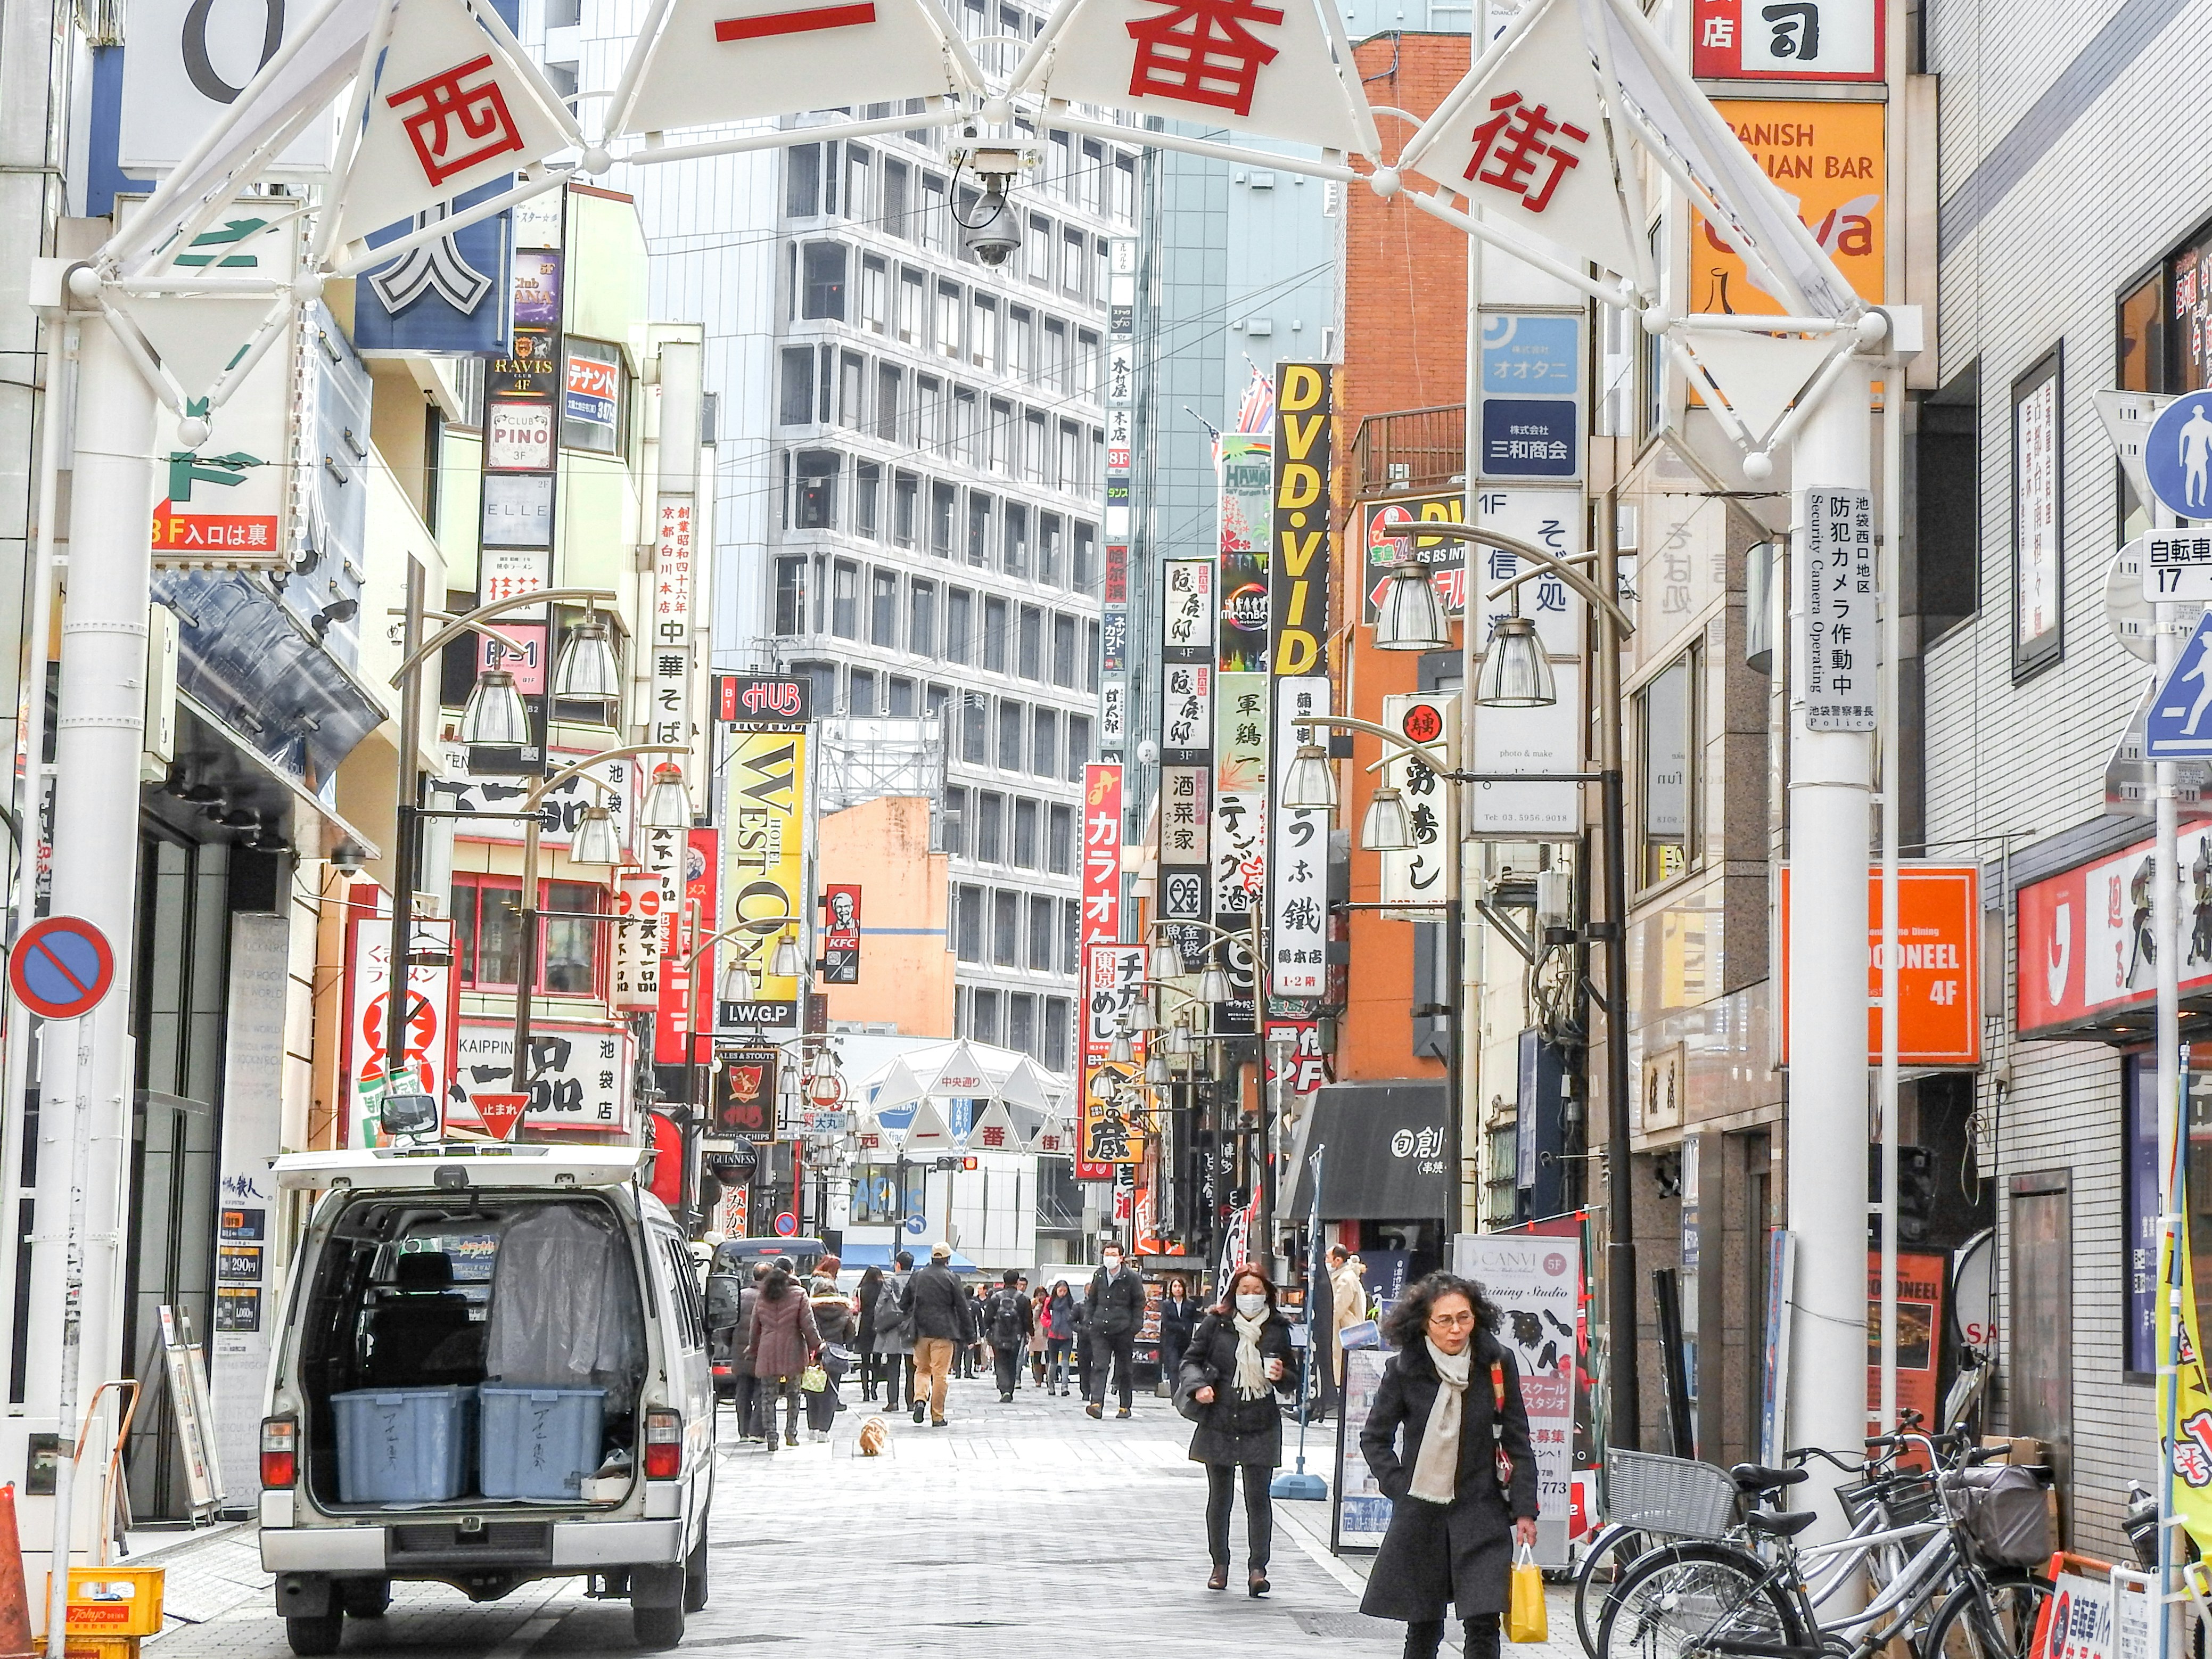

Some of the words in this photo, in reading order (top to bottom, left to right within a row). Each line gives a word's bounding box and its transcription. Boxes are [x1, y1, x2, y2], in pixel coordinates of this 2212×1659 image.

[1702, 16, 1733, 48] 店
[1762, 2, 1818, 61] 司
[385, 53, 524, 188] 西
[1463, 90, 1590, 212] 街
[1825, 157, 1873, 179] BAR
[540, 263, 555, 275] 5F
[495, 359, 553, 373] RAVIS
[1493, 360, 1569, 379] オオタニ
[514, 380, 531, 390] 4F
[1112, 358, 1130, 398] 木村屋
[508, 417, 534, 425] CLUB
[1111, 413, 1128, 442] 本店
[1510, 425, 1549, 436] 株式会社
[495, 429, 548, 445] PINO
[513, 450, 526, 461] 3F
[1109, 452, 1129, 465] 8F
[1490, 440, 1568, 461] 三和商会
[538, 480, 549, 489] 2F
[1108, 488, 1129, 498] ダンス
[488, 504, 547, 516] ELLE
[1478, 494, 1507, 515] 1F
[185, 524, 268, 546] 入口は裏
[1810, 495, 1824, 555] Security
[1433, 549, 1446, 563] BS
[1856, 497, 1870, 594] 池袋西口地区
[2151, 538, 2211, 563] 自転車
[658, 506, 675, 614] 京都白川本店
[675, 506, 690, 615] 創業昭和四十六年
[1811, 560, 1824, 614] Camera
[2158, 569, 2182, 593] 17
[1830, 497, 1852, 696] 防犯カメラ作動中
[1105, 625, 1116, 655] カフェ
[1115, 617, 1125, 648] ネット
[1180, 648, 1194, 658] 4F
[1810, 621, 1825, 693] Operating
[657, 619, 685, 744] 中華そば
[742, 682, 802, 717] HUB
[1104, 689, 1119, 734] 甘太郎
[1809, 706, 1873, 717] 池袋警察署長
[1810, 718, 1873, 727] Police
[1180, 751, 1193, 760] 3F
[1500, 749, 1522, 758] photo
[737, 741, 794, 876] WEST
[1173, 776, 1194, 850] 酒菜家
[769, 819, 781, 868] HOTEL
[1219, 796, 1255, 883] テング
[1912, 927, 1939, 937] Dining
[828, 939, 856, 948] KFC
[638, 919, 657, 992] 天下一品
[367, 966, 438, 983] ラメン
[1096, 951, 1115, 988] 東京
[1117, 953, 1142, 1037] チカ
[1929, 980, 1957, 1005] 4F
[729, 1006, 788, 1022] I.W.G.P
[1092, 992, 1116, 1039] めし
[597, 1040, 615, 1120] 池袋店
[942, 1076, 980, 1088] 中央通り
[482, 1103, 519, 1116] 止まれ
[815, 1118, 837, 1129] 大丸
[861, 1133, 879, 1148] 西
[982, 1126, 1005, 1147] 番
[713, 1153, 755, 1164] GUINNESS
[1221, 1142, 1235, 1175] 博多
[232, 1258, 256, 1272] 290円
[1482, 1253, 1535, 1266] CANVI
[1548, 1259, 1561, 1270] 5F
[1486, 1286, 1522, 1300] aining
[1528, 1286, 1568, 1297] Studio
[1522, 1383, 1567, 1394] スクール
[1523, 1397, 1566, 1410] スタジオ
